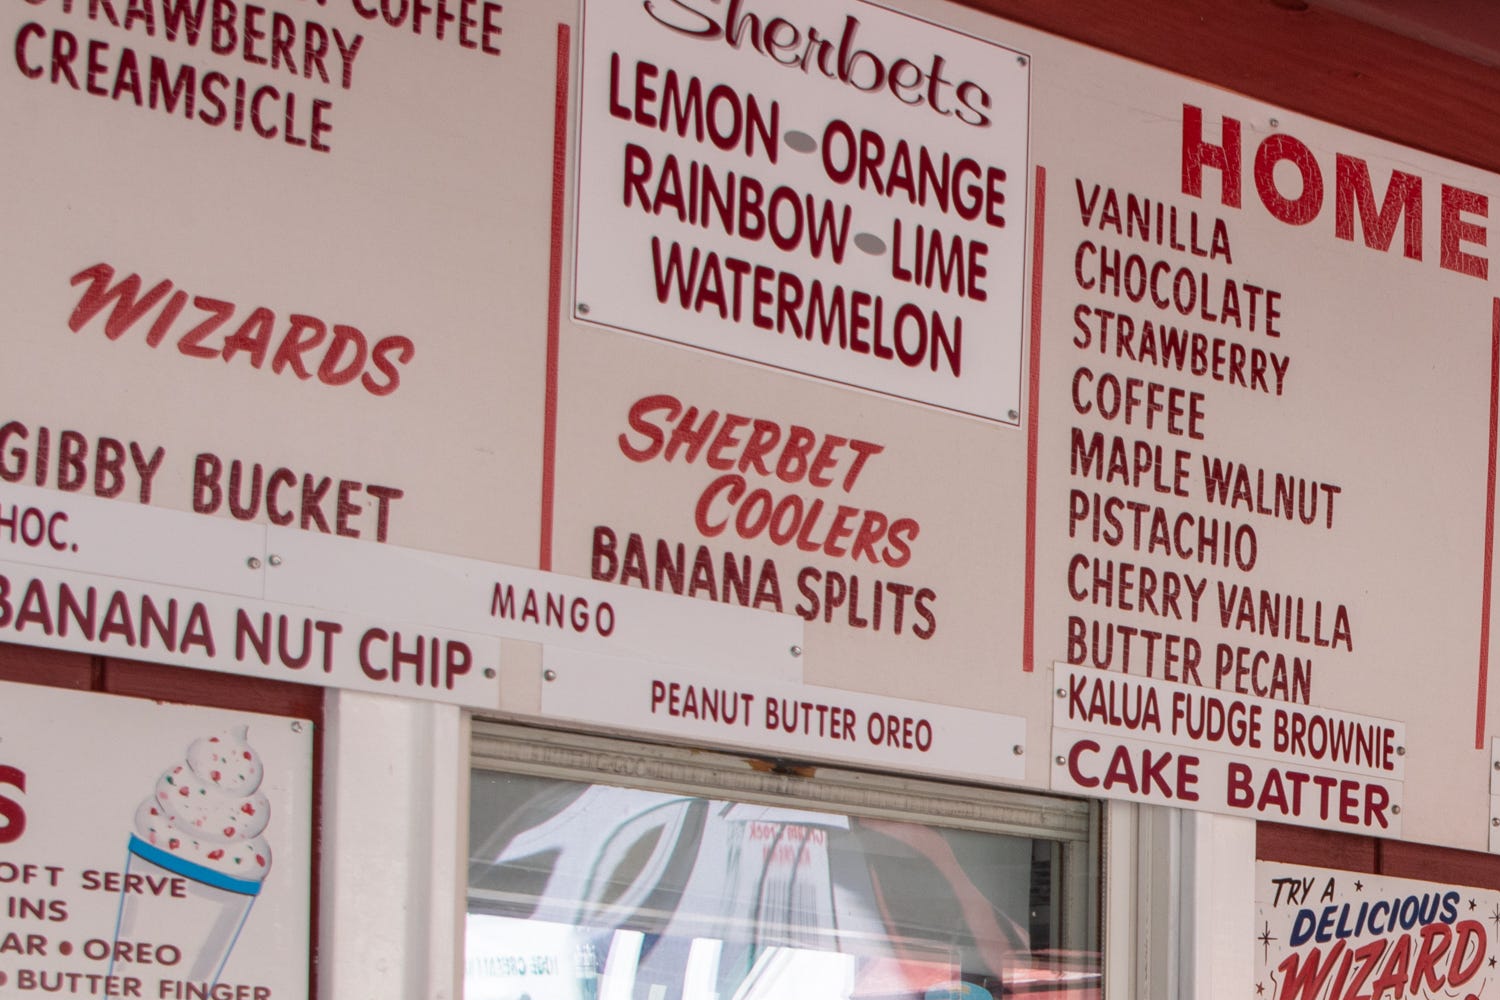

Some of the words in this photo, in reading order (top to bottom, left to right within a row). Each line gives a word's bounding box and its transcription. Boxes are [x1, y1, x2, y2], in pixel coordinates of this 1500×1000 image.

[14, 21, 334, 153] CREAMSICLE
[609, 51, 780, 164] LEMON
[821, 119, 1007, 229] ORANGE
[622, 142, 852, 265] RAINBOW
[892, 218, 989, 302] LIME
[1075, 177, 1233, 265] VANILLA
[1180, 102, 1490, 282] HOME
[68, 261, 416, 397] WIZARDS
[650, 235, 963, 378] WATERMELON
[1074, 240, 1283, 338] CHOCOLATE
[1072, 303, 1291, 397] STRAWBERRY
[617, 394, 886, 493] SHERBET
[1071, 366, 1206, 440] COFFEE
[0, 420, 165, 504] GIBBY
[192, 453, 404, 543] BUCKET
[694, 474, 920, 567] COOLERS
[1070, 426, 1193, 497] MAPLE
[1202, 453, 1342, 530] WALNUT
[1068, 488, 1258, 573] PISTACHIO
[490, 582, 616, 637] MANGO
[591, 525, 783, 613] BANANA
[795, 566, 937, 640] SPLITS
[234, 608, 342, 674] NUT
[358, 627, 473, 691] CHIP
[651, 680, 754, 727] PEANUT
[766, 696, 856, 741] BUTTER
[867, 711, 933, 753] OREO
[1068, 739, 1201, 803] CAKE
[1227, 761, 1391, 829] BATTER
[81, 869, 187, 899] SERVE
[1289, 890, 1461, 948] DELICIOUS
[17, 969, 143, 998] BUTTER
[83, 938, 182, 966] OREO
